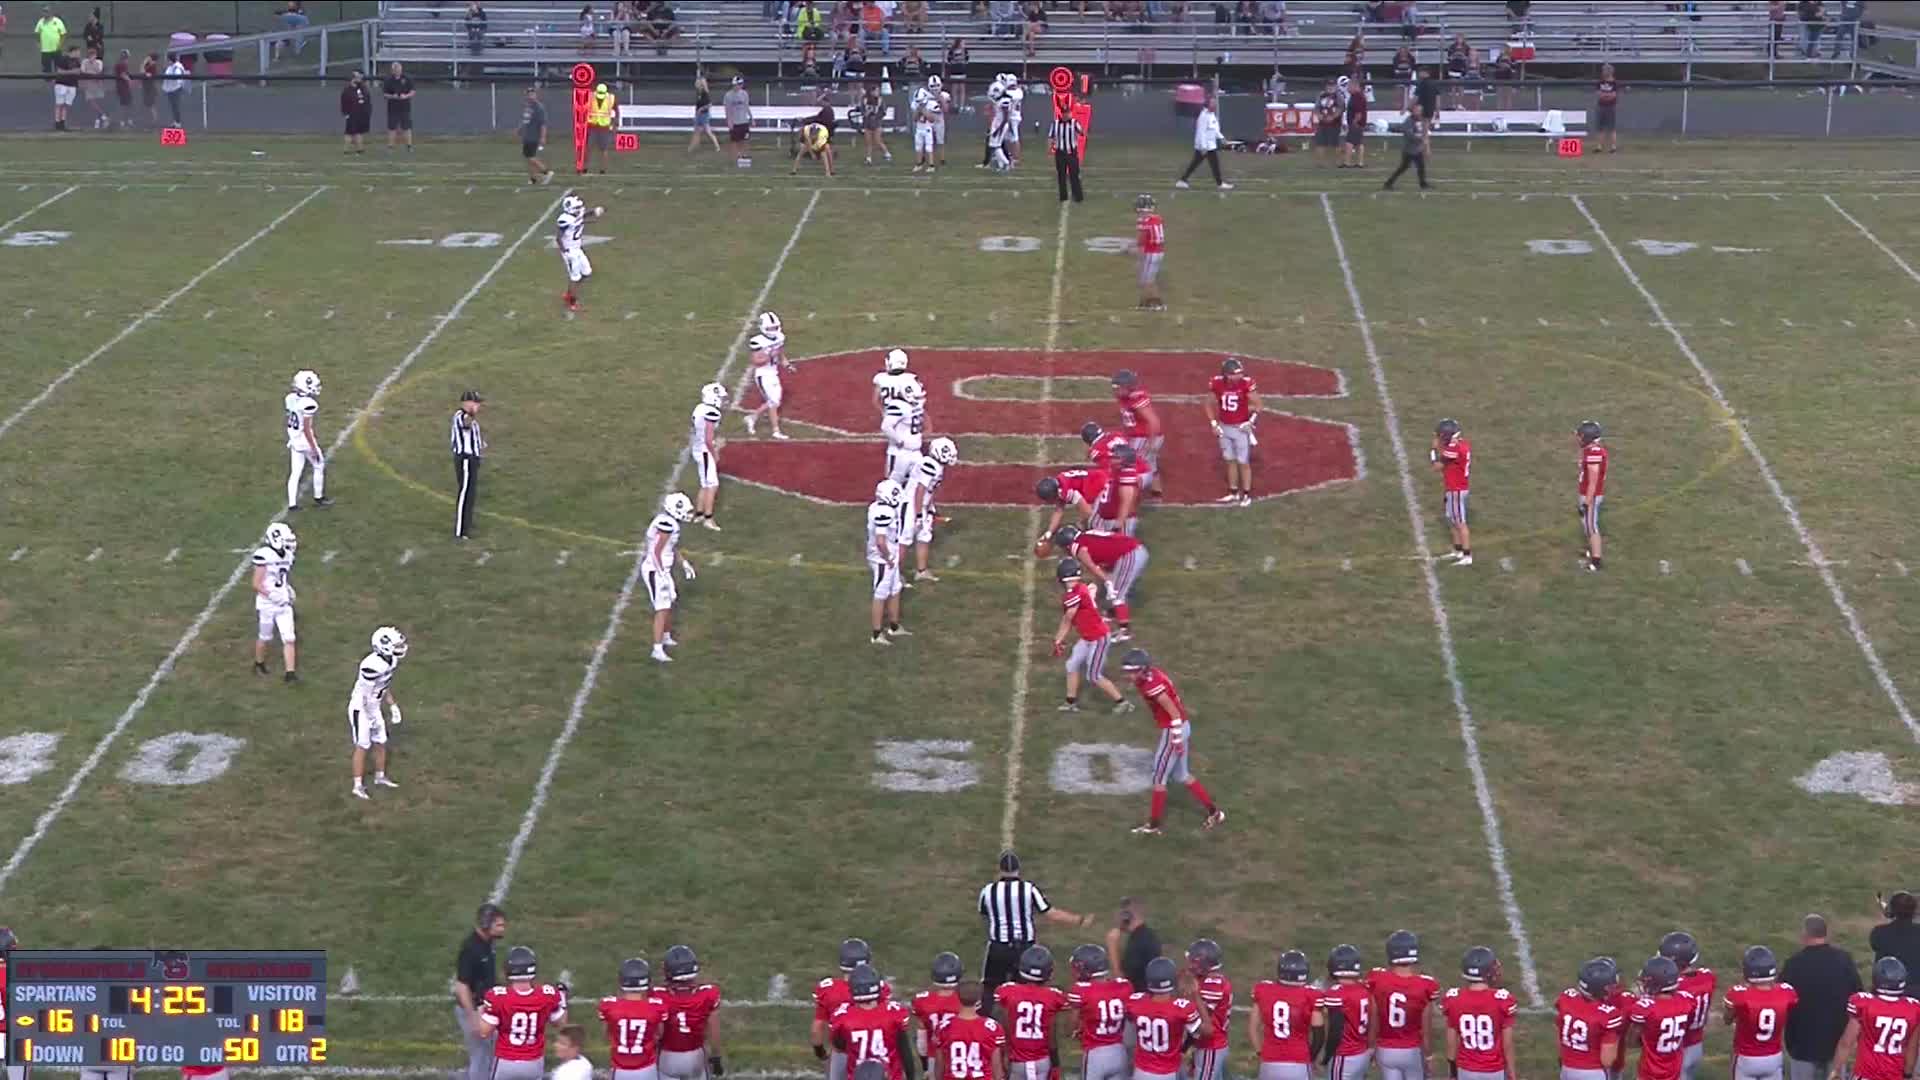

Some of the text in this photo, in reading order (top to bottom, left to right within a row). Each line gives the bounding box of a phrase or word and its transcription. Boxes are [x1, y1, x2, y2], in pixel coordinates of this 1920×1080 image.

[1221, 395, 1240, 412] 15
[508, 1011, 539, 1046] 81
[676, 1011, 692, 1034] 1
[1015, 1000, 1045, 1040] 21
[1095, 998, 1125, 1035] 19
[1272, 1000, 1291, 1039] 8
[1388, 991, 1408, 1028] 6
[1755, 1008, 1777, 1042] 9
[617, 1018, 648, 1055] 17
[850, 1028, 891, 1066] 74
[1136, 1015, 1170, 1053] 20
[1459, 1013, 1495, 1051] 88
[1562, 1013, 1590, 1051] 12
[1655, 1014, 1690, 1053] 25
[1873, 1015, 1908, 1055] 72
[950, 1040, 985, 1079] 84
